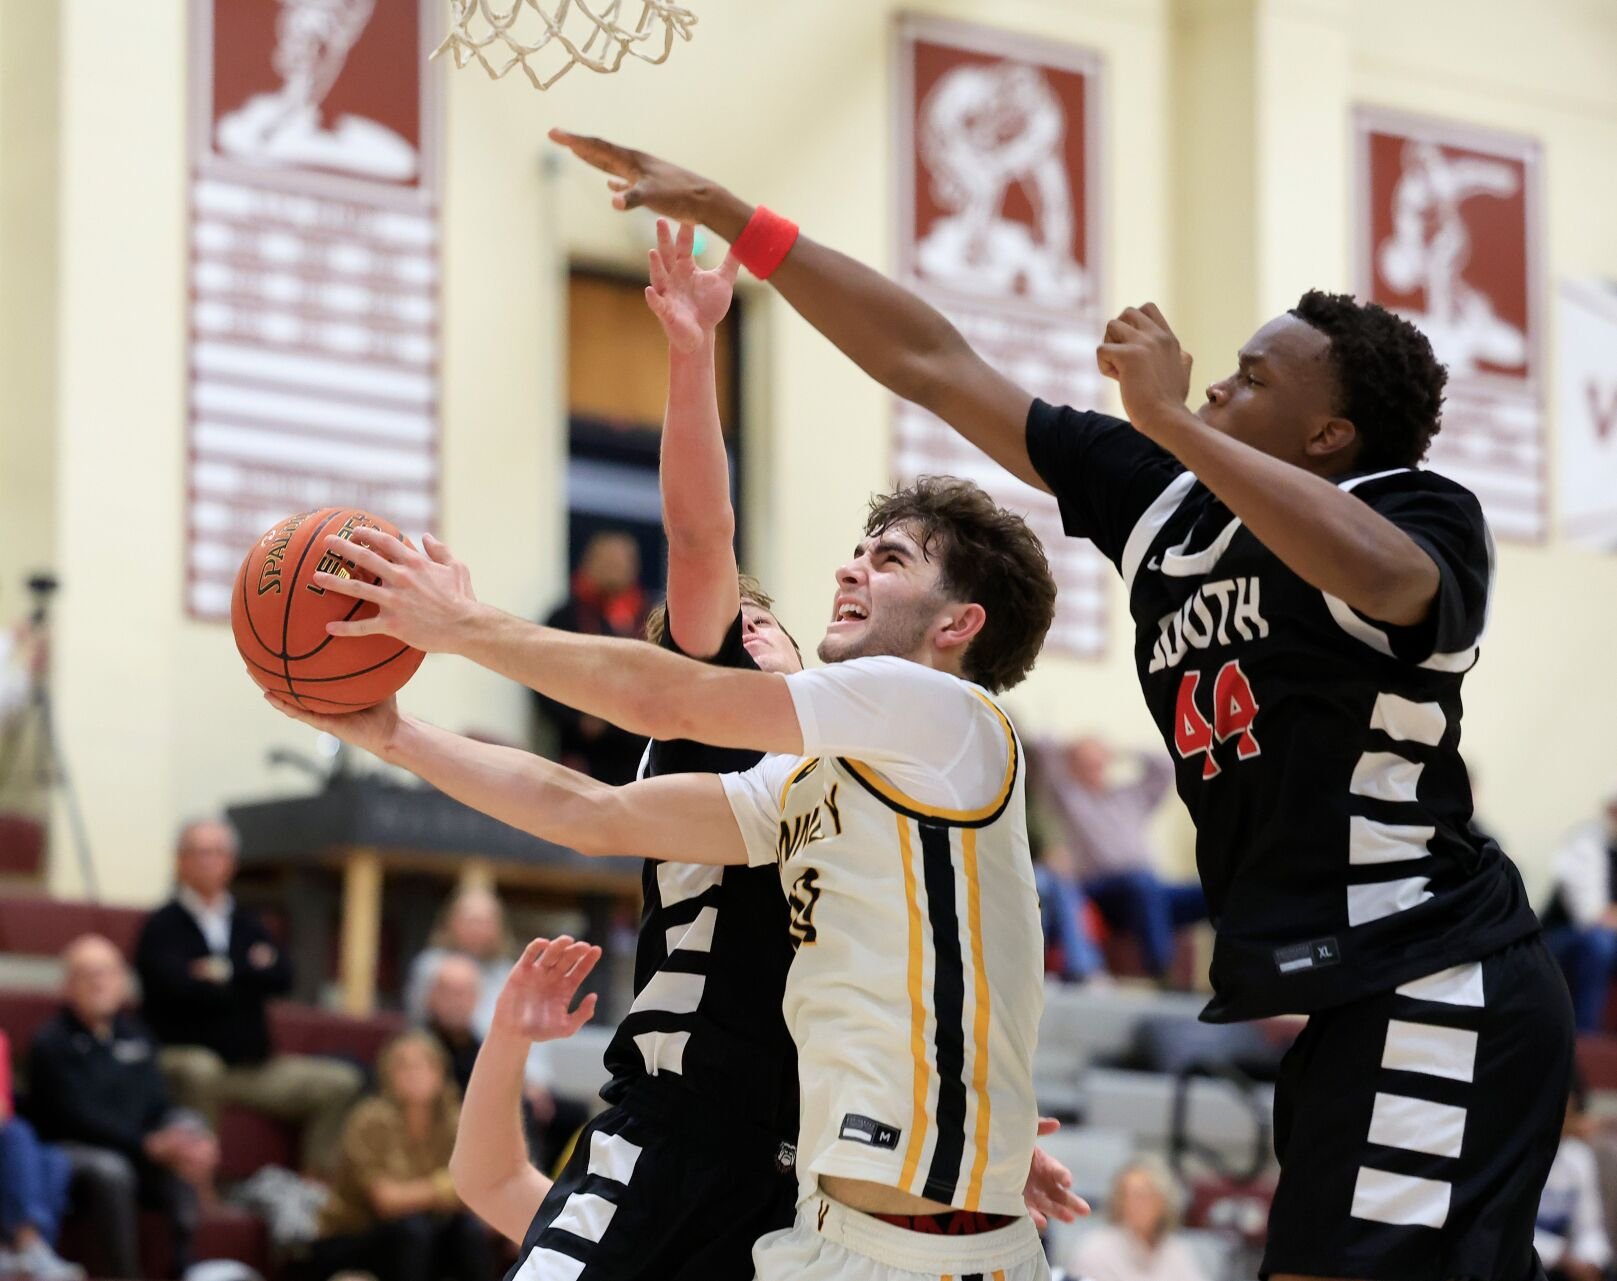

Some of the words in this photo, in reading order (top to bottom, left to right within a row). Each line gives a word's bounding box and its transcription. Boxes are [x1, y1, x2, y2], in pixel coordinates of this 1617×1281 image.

[1174, 658, 1260, 780] 44
[1317, 945, 1333, 959] XL
[879, 1131, 891, 1142] M
